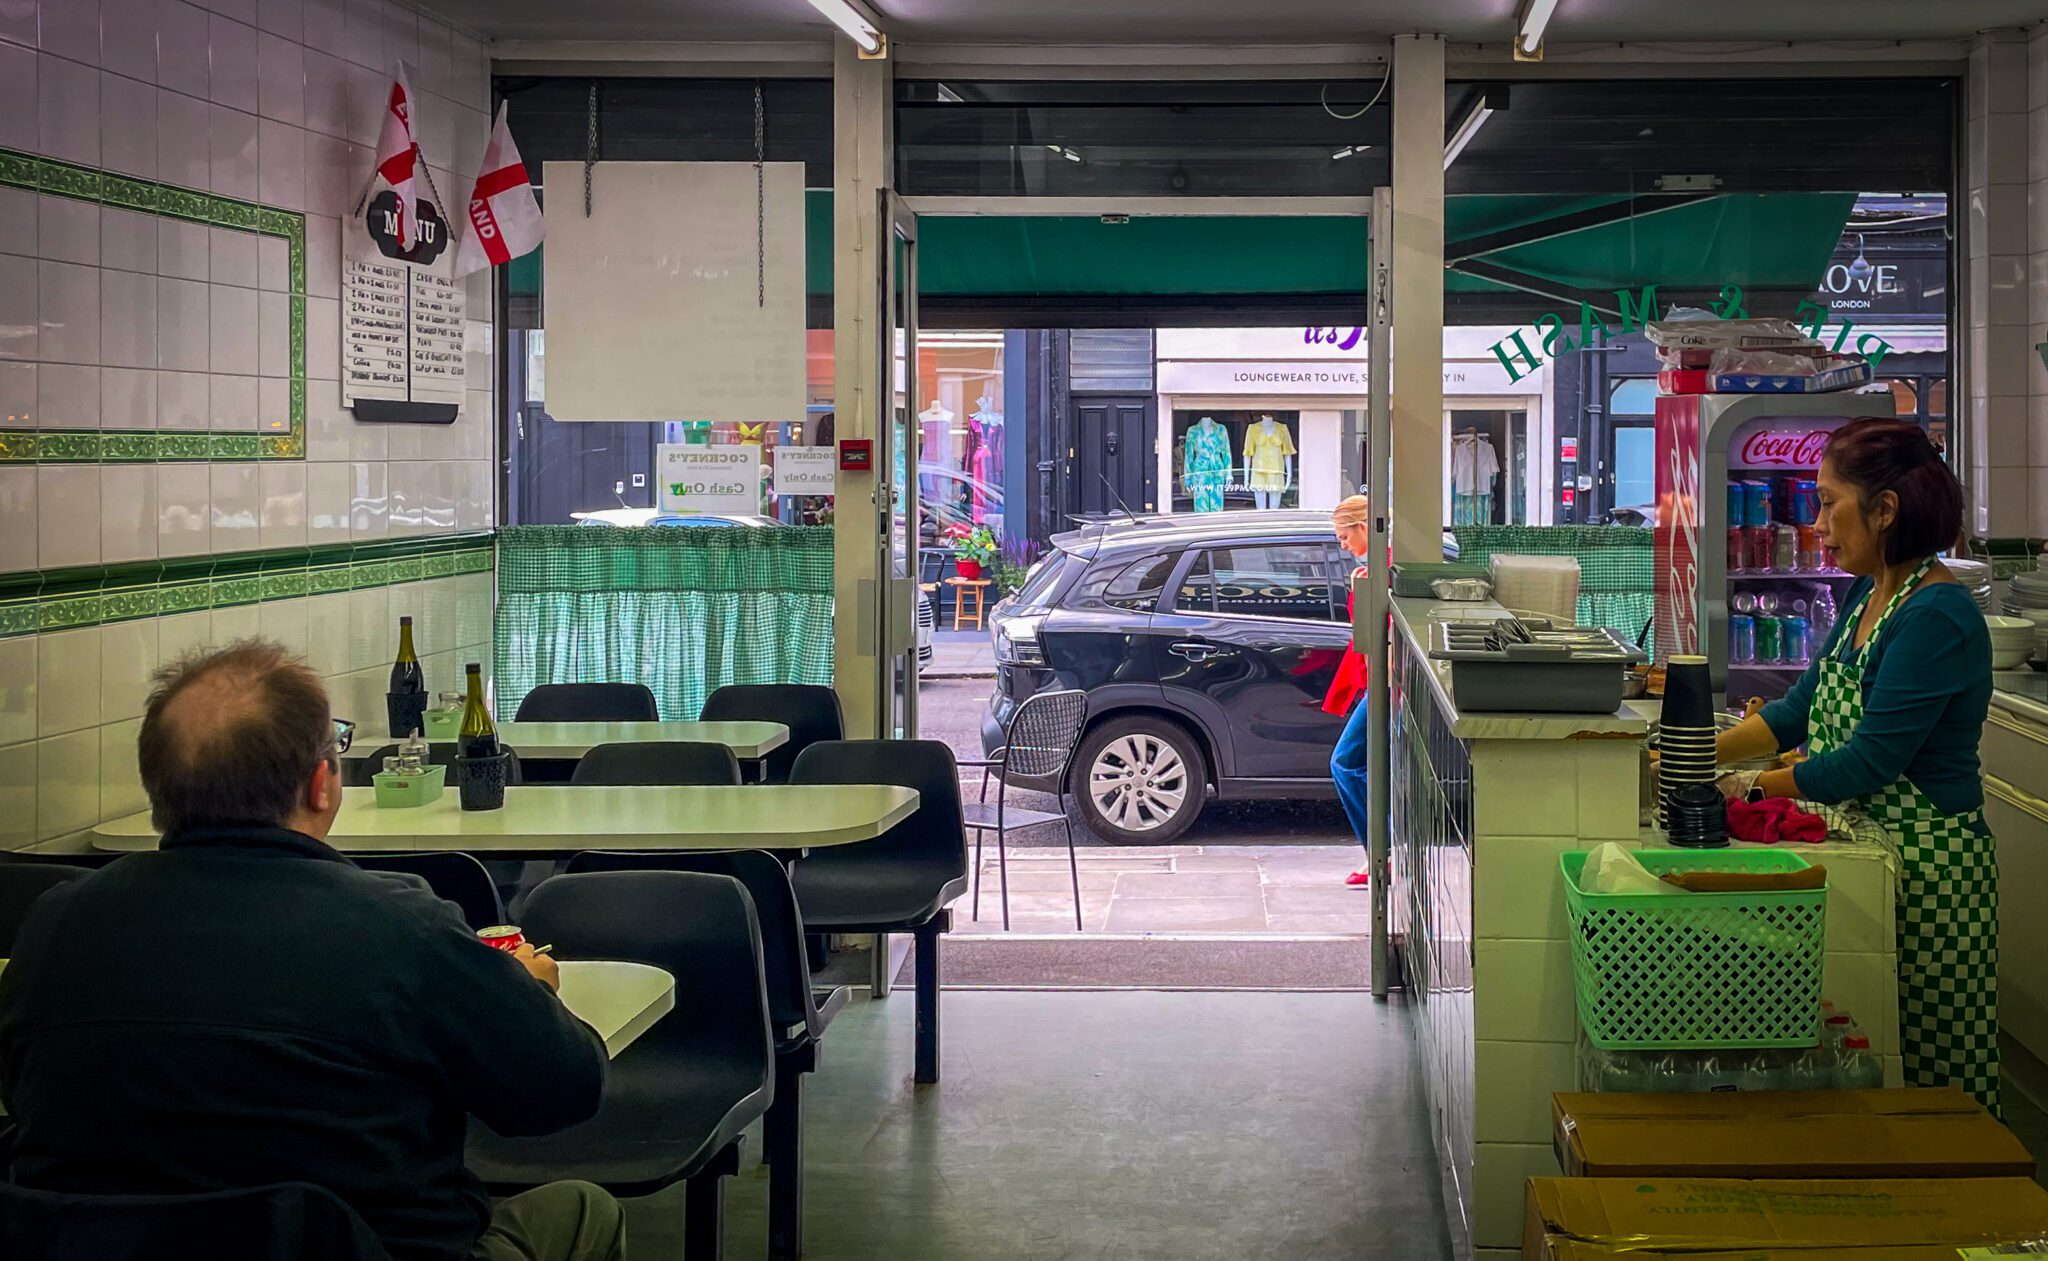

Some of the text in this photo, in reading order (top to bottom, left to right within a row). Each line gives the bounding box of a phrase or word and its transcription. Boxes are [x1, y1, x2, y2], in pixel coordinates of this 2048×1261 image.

[384, 211, 435, 243] MNU
[1818, 264, 1898, 293] OVE
[1831, 300, 1871, 308] LONDON
[1680, 335, 1707, 346] Coke
[1234, 372, 1312, 382] LOUNGEWEAR
[1314, 372, 1329, 382] TO
[1332, 372, 1360, 384] LIVE,
[1453, 374, 1466, 382] IN
[1741, 430, 1831, 465] Coca-Co
